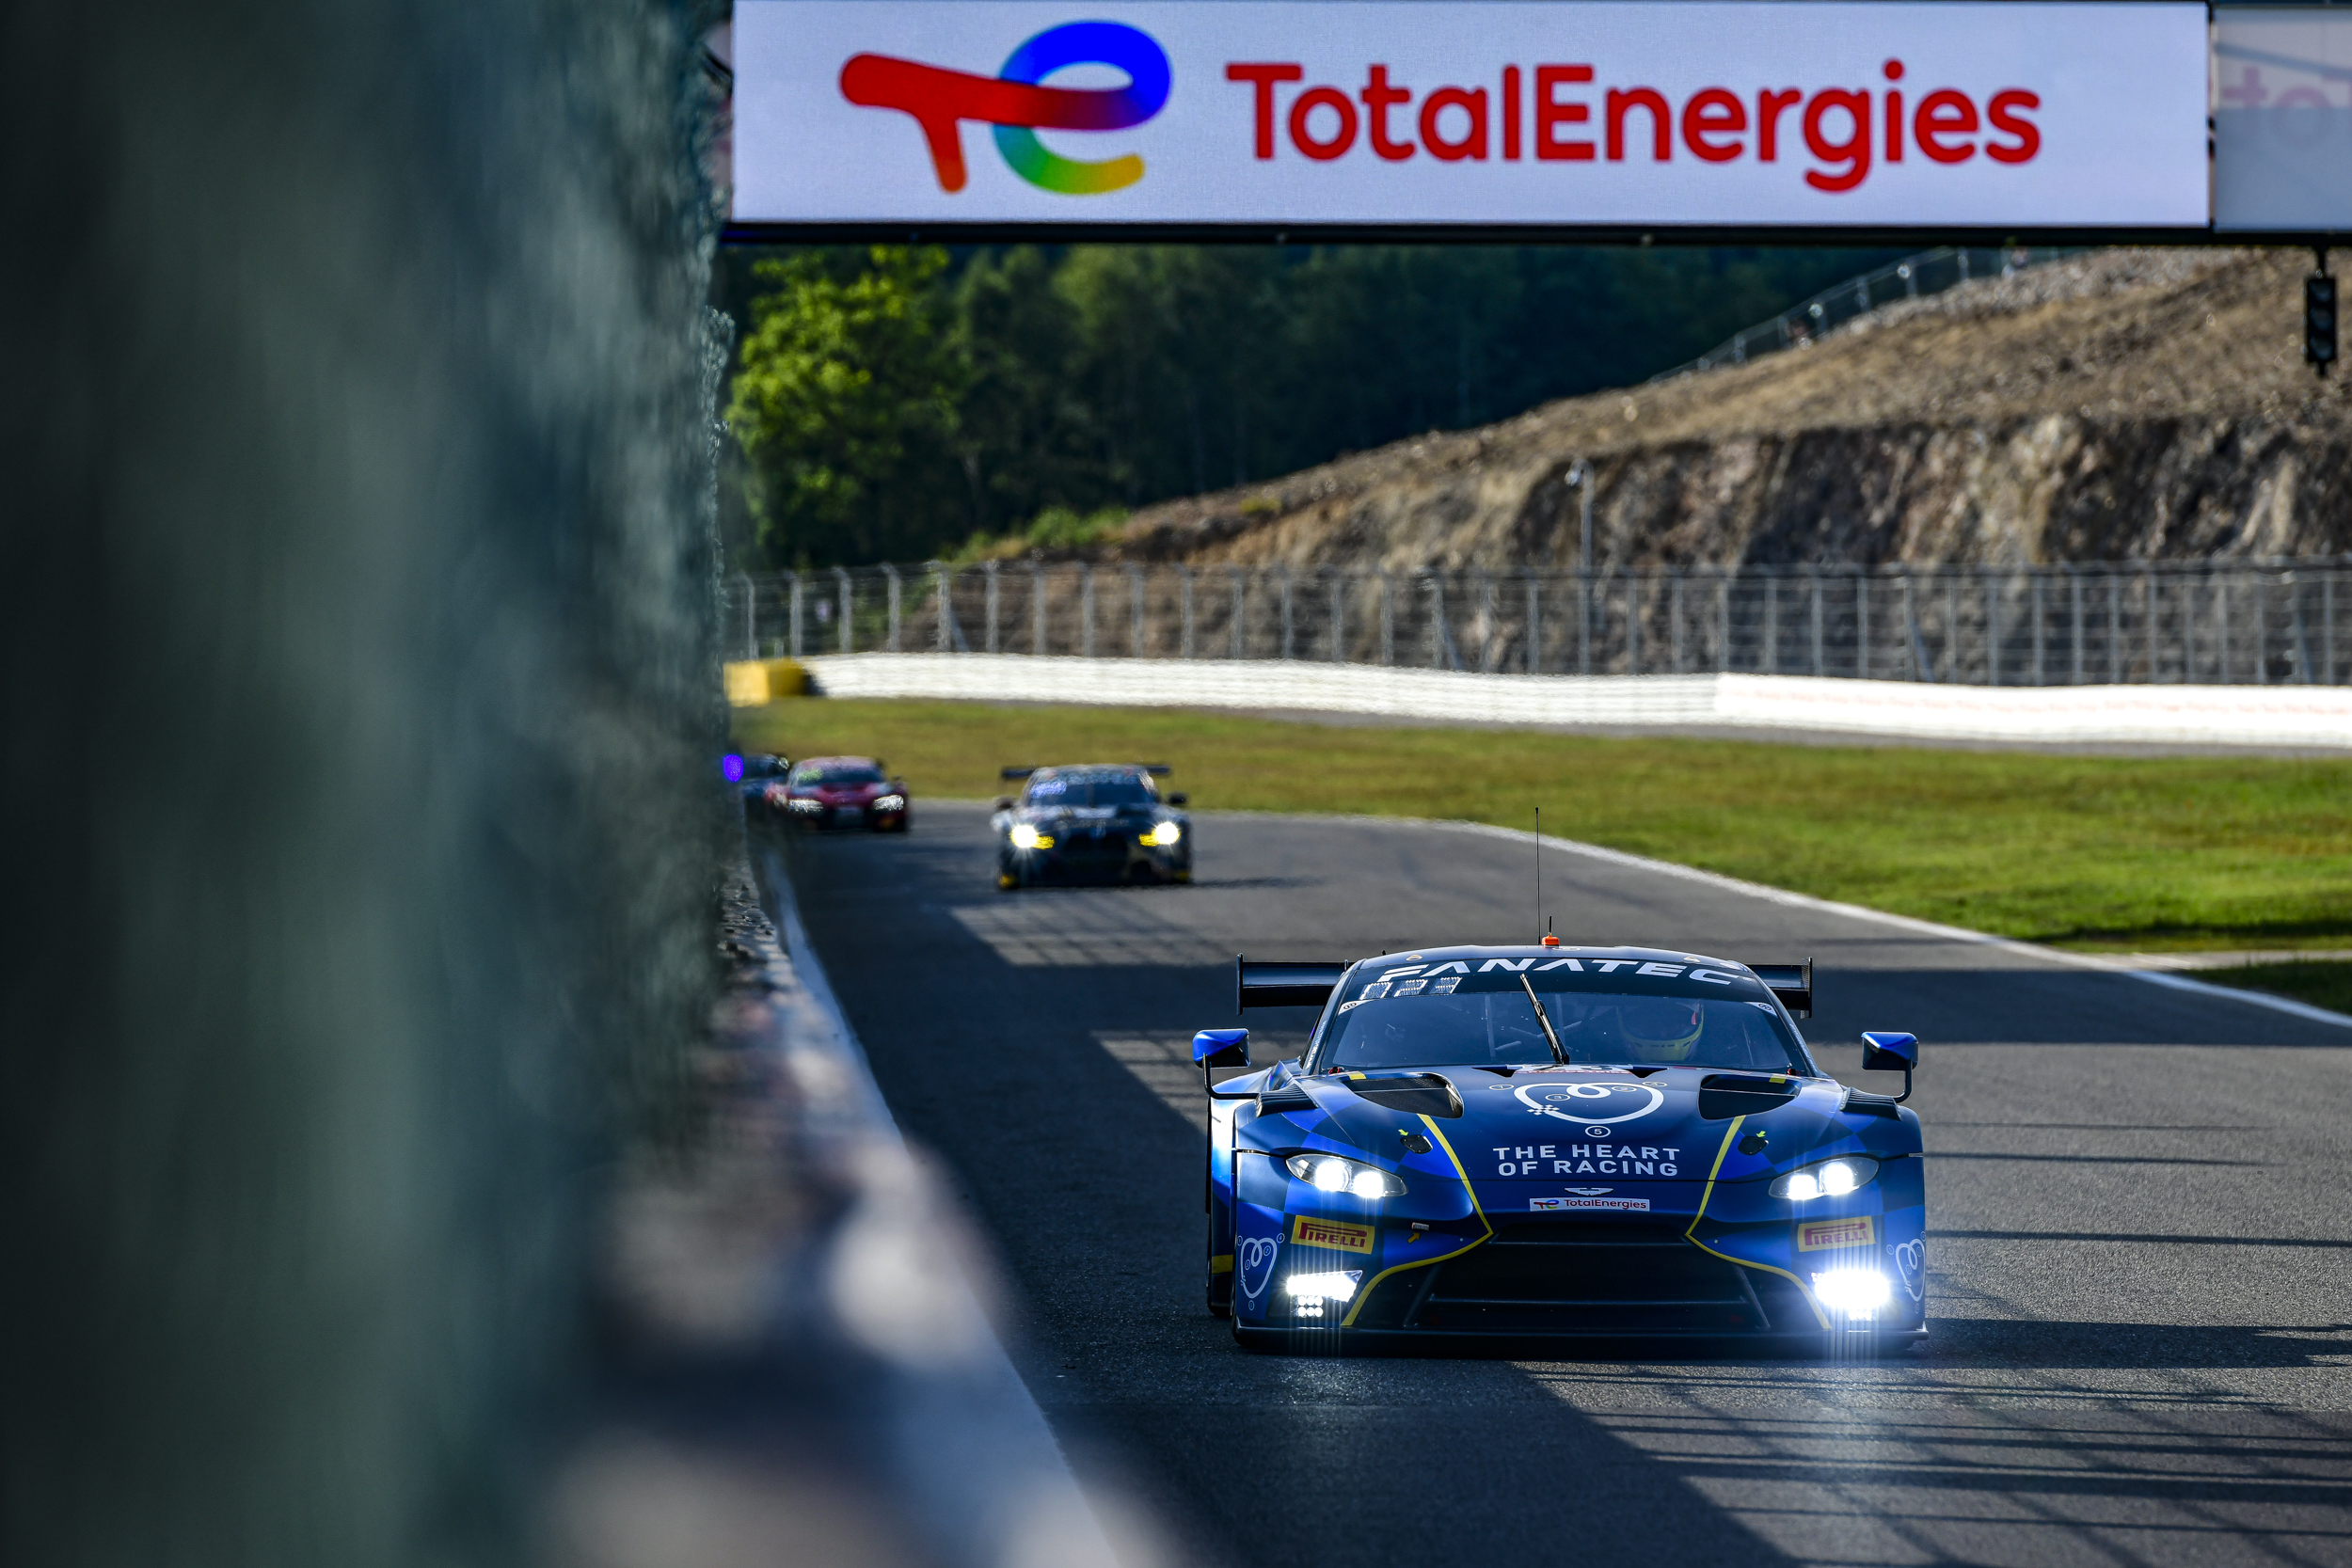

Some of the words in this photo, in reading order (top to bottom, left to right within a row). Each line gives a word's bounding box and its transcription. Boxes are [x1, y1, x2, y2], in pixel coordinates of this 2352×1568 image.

[1224, 57, 2042, 194] TotalEnergies
[1376, 958, 1740, 985] FANATEC
[1493, 1145, 1556, 1160] THE
[1571, 1144, 1680, 1160] HEART
[1498, 1161, 1538, 1176] OF
[1553, 1160, 1677, 1176] RACING
[1564, 1198, 1647, 1210] TotalEnergies
[1298, 1222, 1368, 1248] PIRELLI
[1804, 1223, 1868, 1246] PIRELLI
